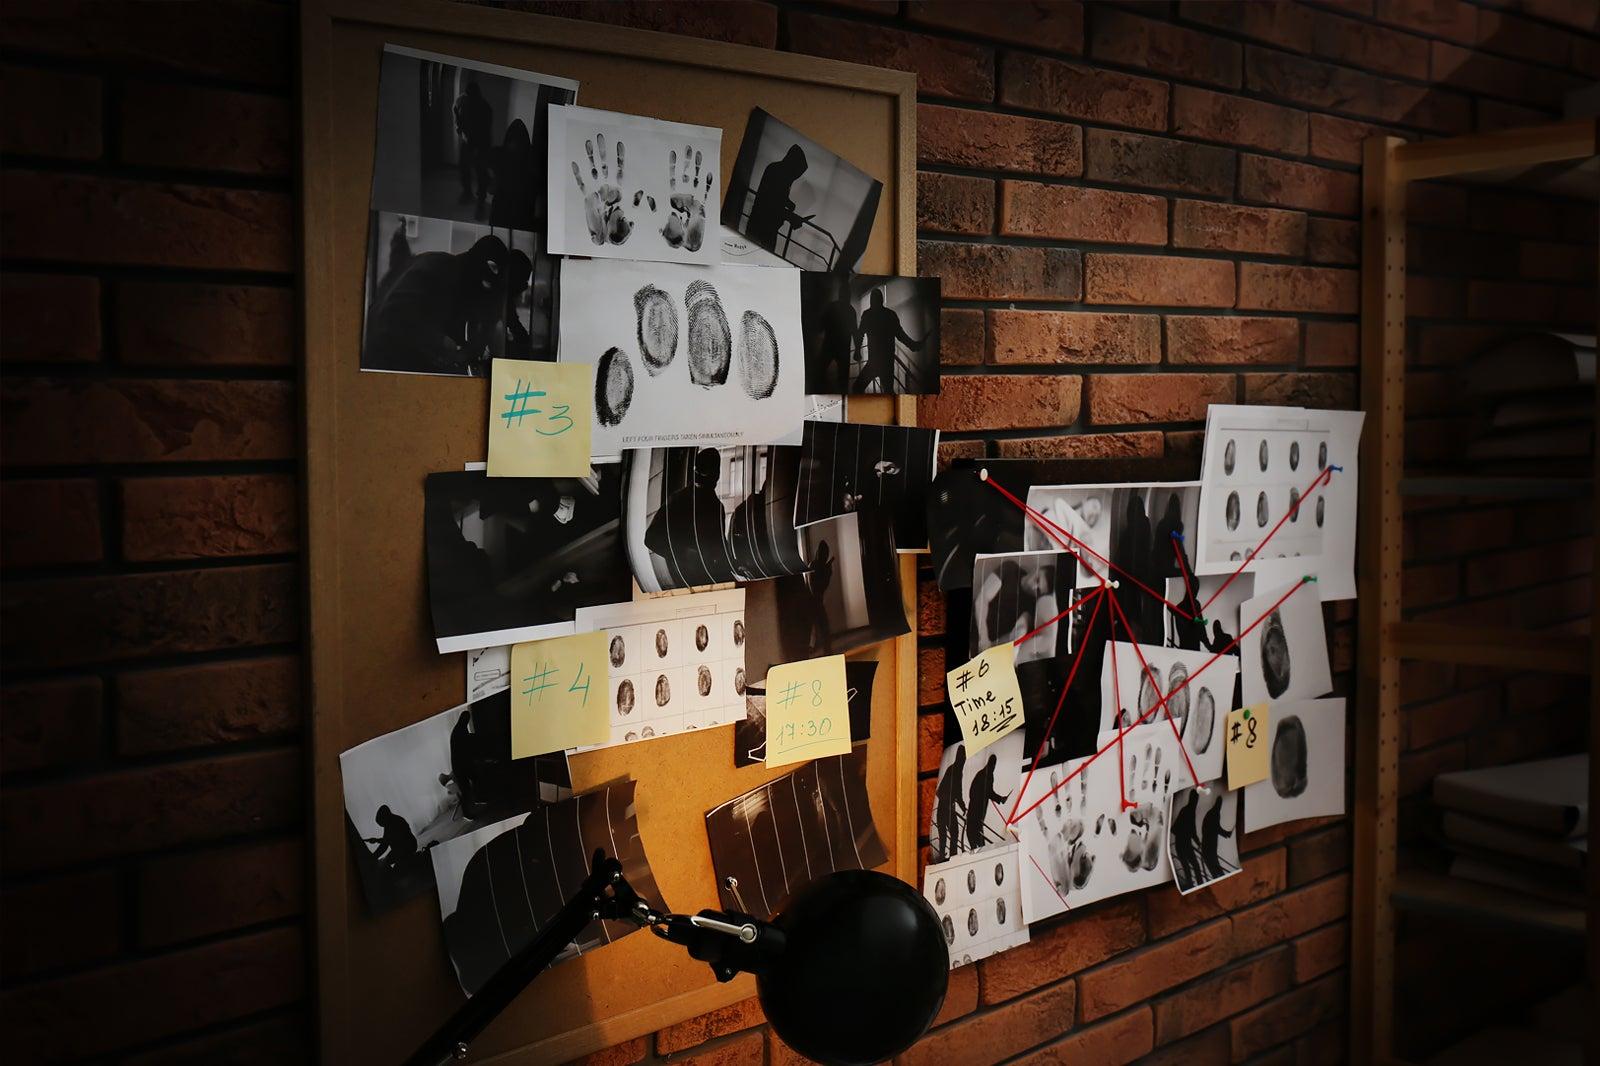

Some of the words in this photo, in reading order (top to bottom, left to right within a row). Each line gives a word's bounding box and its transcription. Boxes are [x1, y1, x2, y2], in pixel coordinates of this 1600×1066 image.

[953, 690, 997, 717] Time
[972, 697, 1014, 737] 18:15
[775, 718, 832, 743] 17:30
